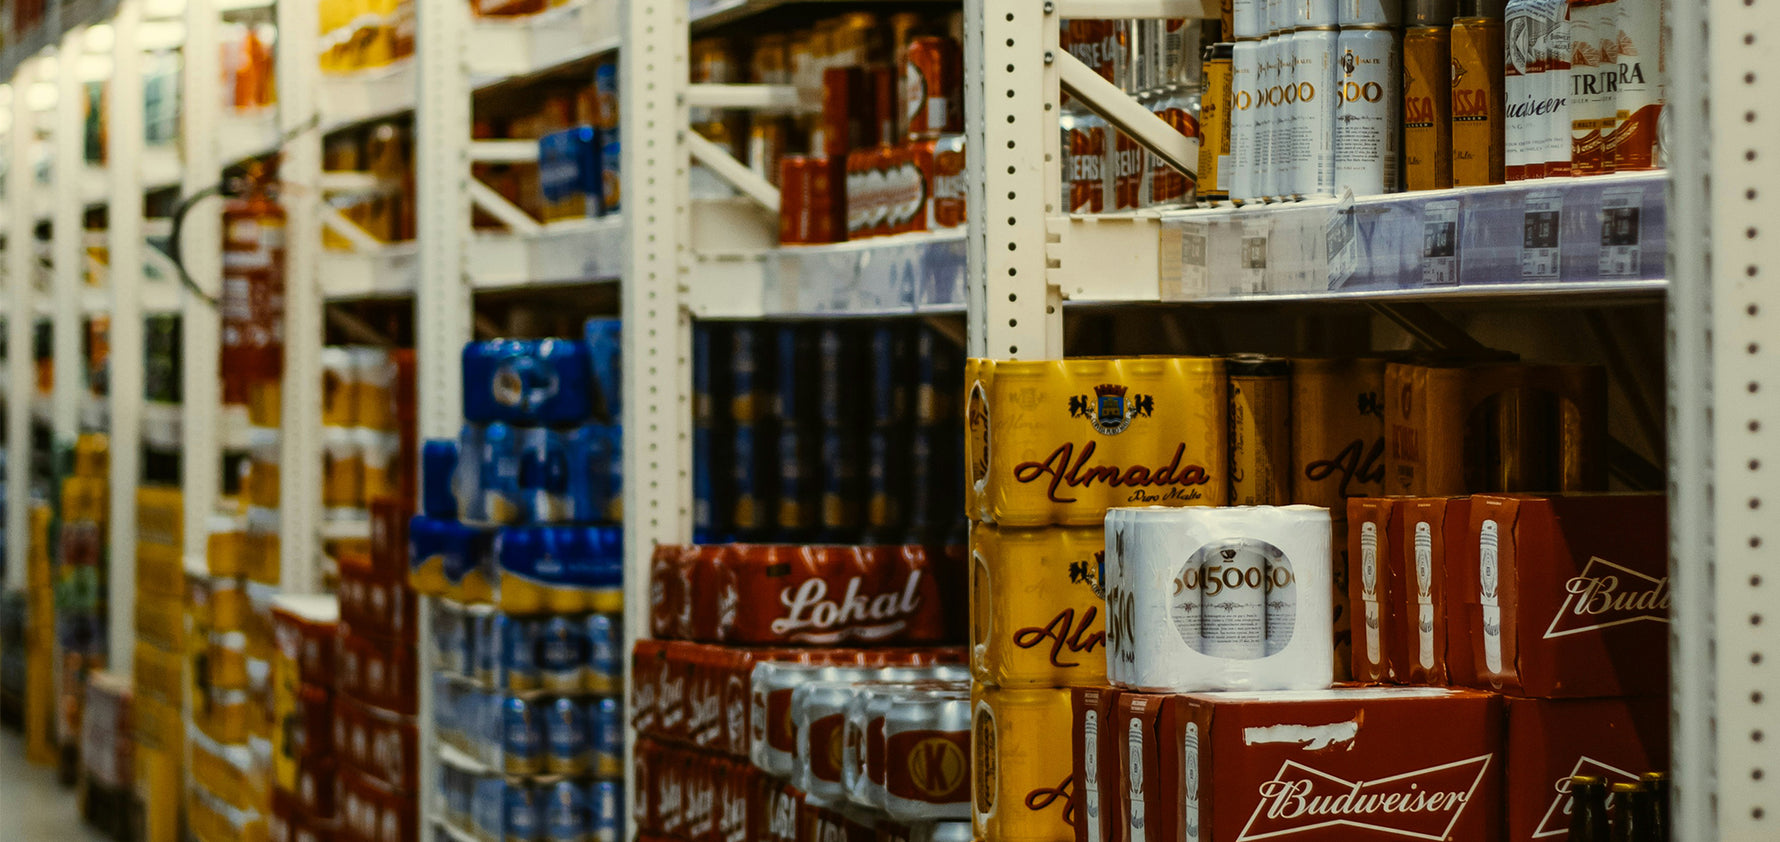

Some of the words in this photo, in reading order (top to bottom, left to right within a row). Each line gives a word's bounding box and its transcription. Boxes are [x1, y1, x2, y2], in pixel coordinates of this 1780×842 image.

[1014, 440, 1210, 503] Almada
[1128, 489, 1159, 502] Puro
[1163, 487, 1202, 500] Malte
[771, 569, 921, 634] Lokal
[924, 742, 949, 792] K
[1259, 778, 1468, 819] Budweiser
